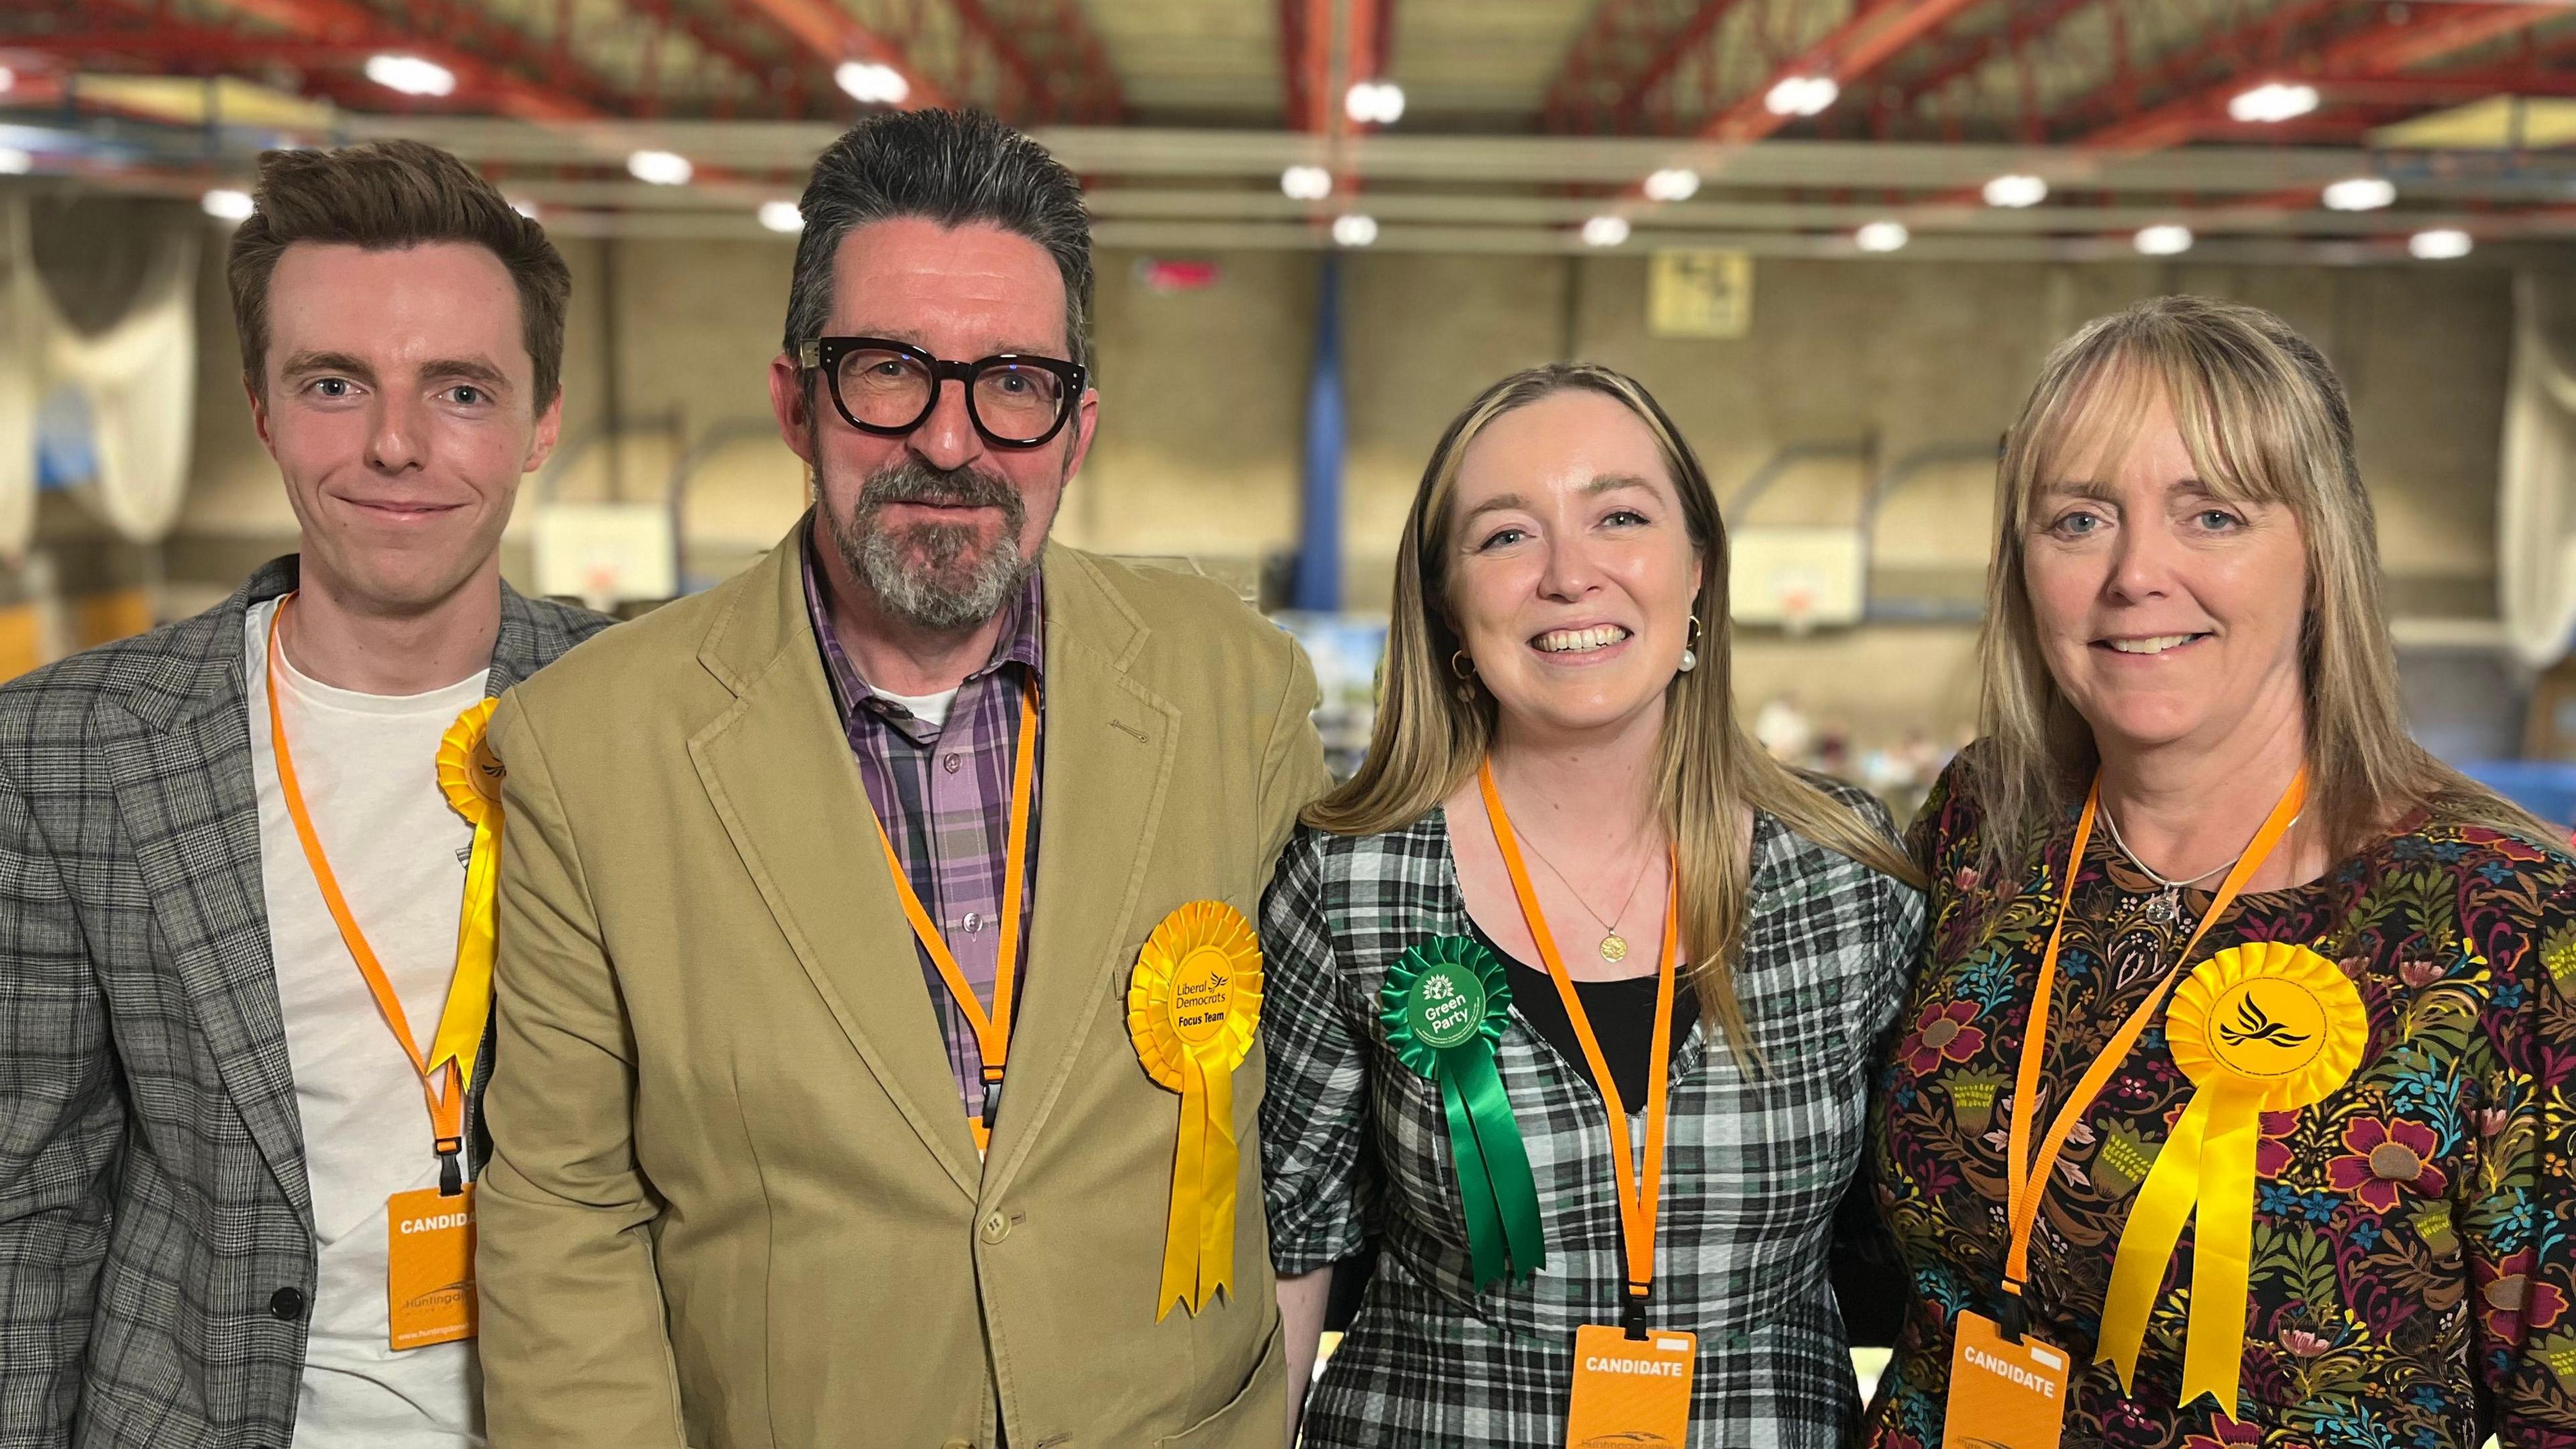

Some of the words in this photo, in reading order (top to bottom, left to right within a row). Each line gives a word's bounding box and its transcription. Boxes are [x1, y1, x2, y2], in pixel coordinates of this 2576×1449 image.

[1177, 980, 1207, 996] Liberal
[1176, 993, 1226, 1009] Democrats
[1425, 994, 1466, 1021] Green
[1179, 1016, 1202, 1028] Focus
[1204, 1012, 1224, 1023] Team
[1432, 1008, 1468, 1034] Party
[1586, 1356, 1682, 1377] CANDIDATE
[1964, 1346, 2055, 1399] CANDIDATE
